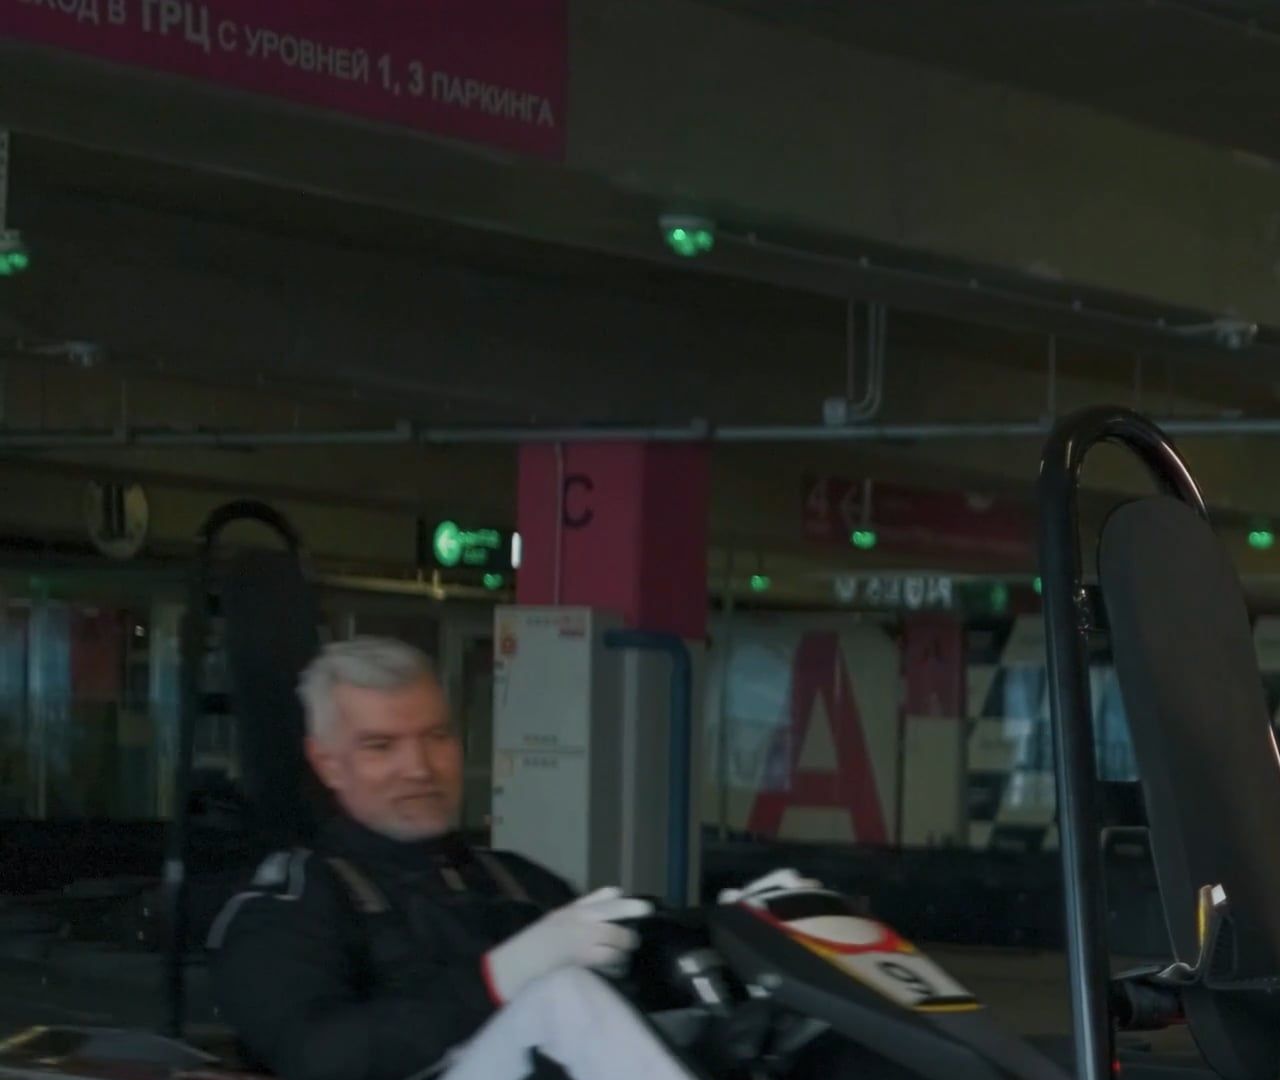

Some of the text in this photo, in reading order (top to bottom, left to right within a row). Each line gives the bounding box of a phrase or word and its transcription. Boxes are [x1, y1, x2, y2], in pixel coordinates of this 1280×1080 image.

[218, 20, 238, 51] С
[245, 25, 369, 85] УРОВНЕЙ
[408, 60, 425, 97] 3
[432, 71, 555, 128] ПАРКИНГА
[562, 474, 594, 530] C
